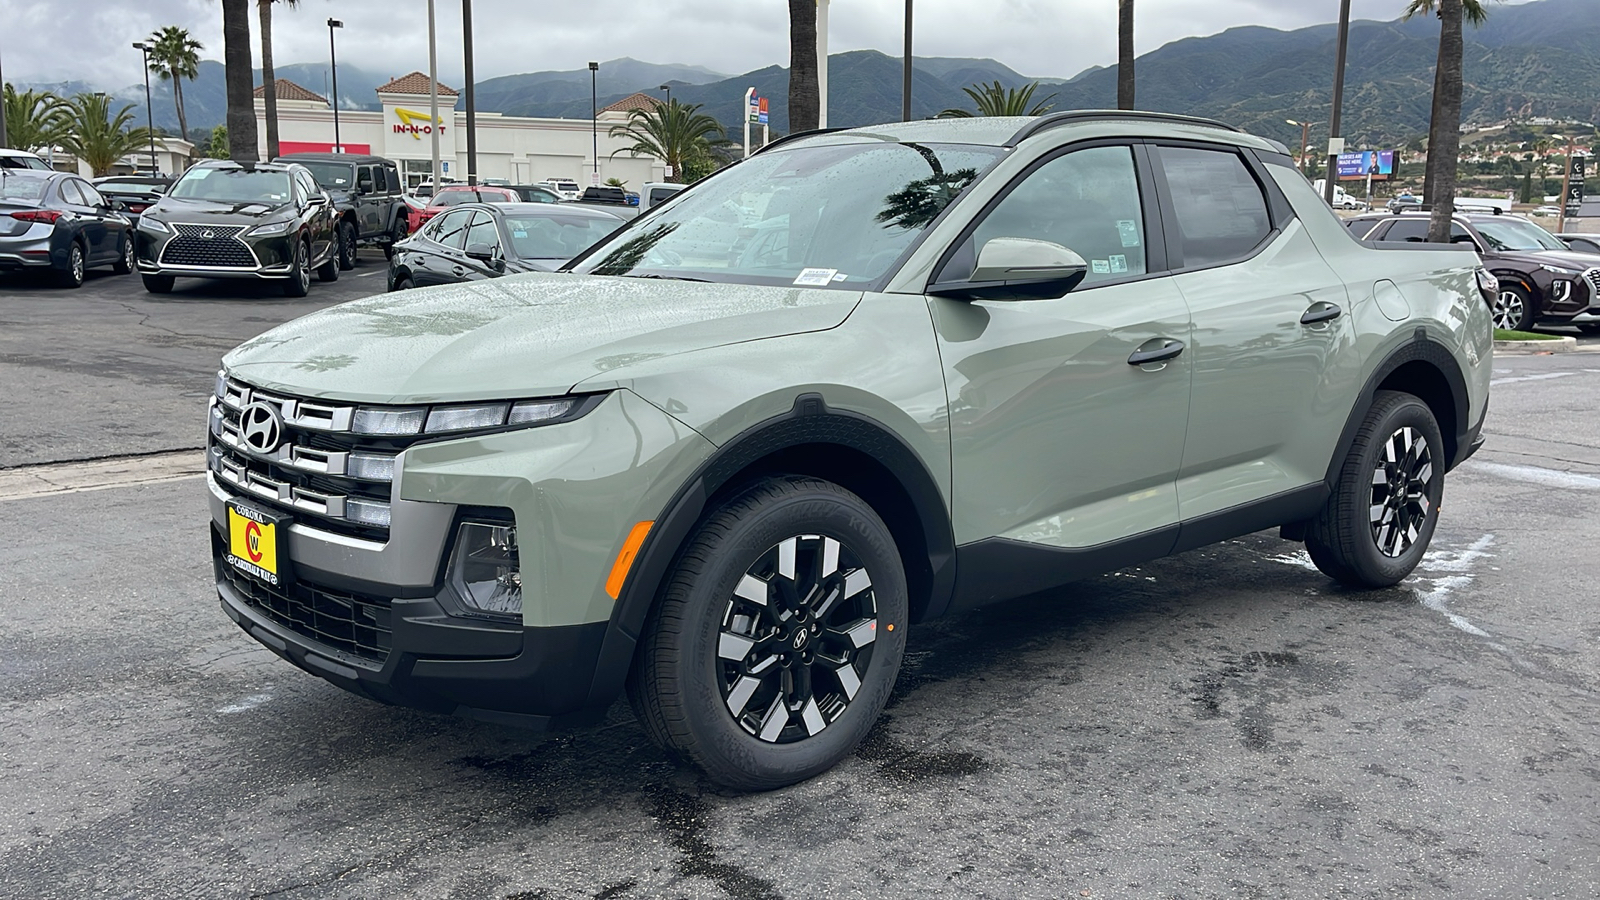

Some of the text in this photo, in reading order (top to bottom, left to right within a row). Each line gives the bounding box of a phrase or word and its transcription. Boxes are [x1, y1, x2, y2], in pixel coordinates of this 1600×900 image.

[393, 124, 446, 135] IN-N-OT
[236, 505, 264, 523] CORONA
[260, 568, 271, 582] WAY
